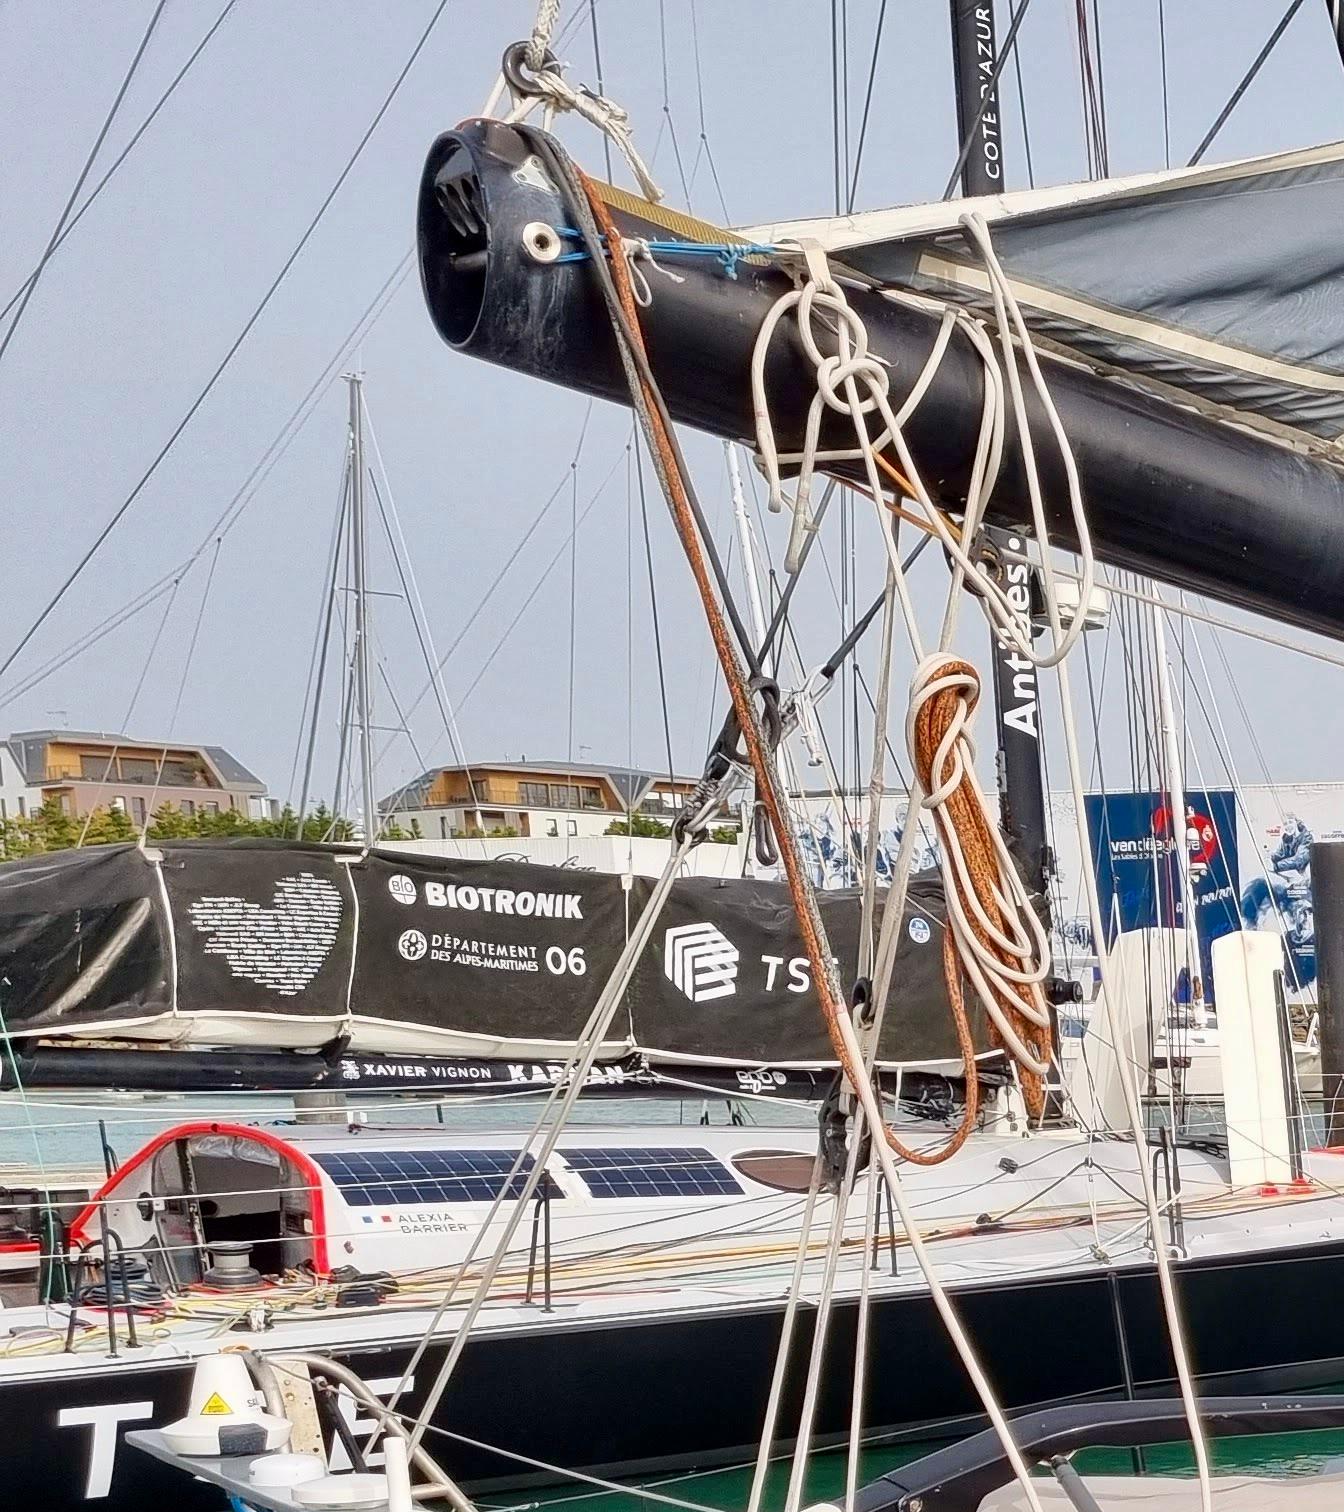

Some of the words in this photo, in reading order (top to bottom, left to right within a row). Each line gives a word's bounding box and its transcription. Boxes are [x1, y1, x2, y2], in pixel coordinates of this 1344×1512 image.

[982, 111, 1001, 180] COTE
[392, 880, 414, 894] BIO
[425, 881, 584, 920] BIOTRONIK
[431, 933, 538, 959] DÉPARTEMENT
[431, 950, 451, 962] DES
[453, 953, 539, 972] ALPES-MARITIMES
[545, 946, 587, 976] 06
[364, 1063, 427, 1079] XAVIER
[431, 1066, 492, 1080] VIGNON
[399, 1212, 454, 1223] ALEXIA
[401, 1223, 468, 1234] BARRIER
